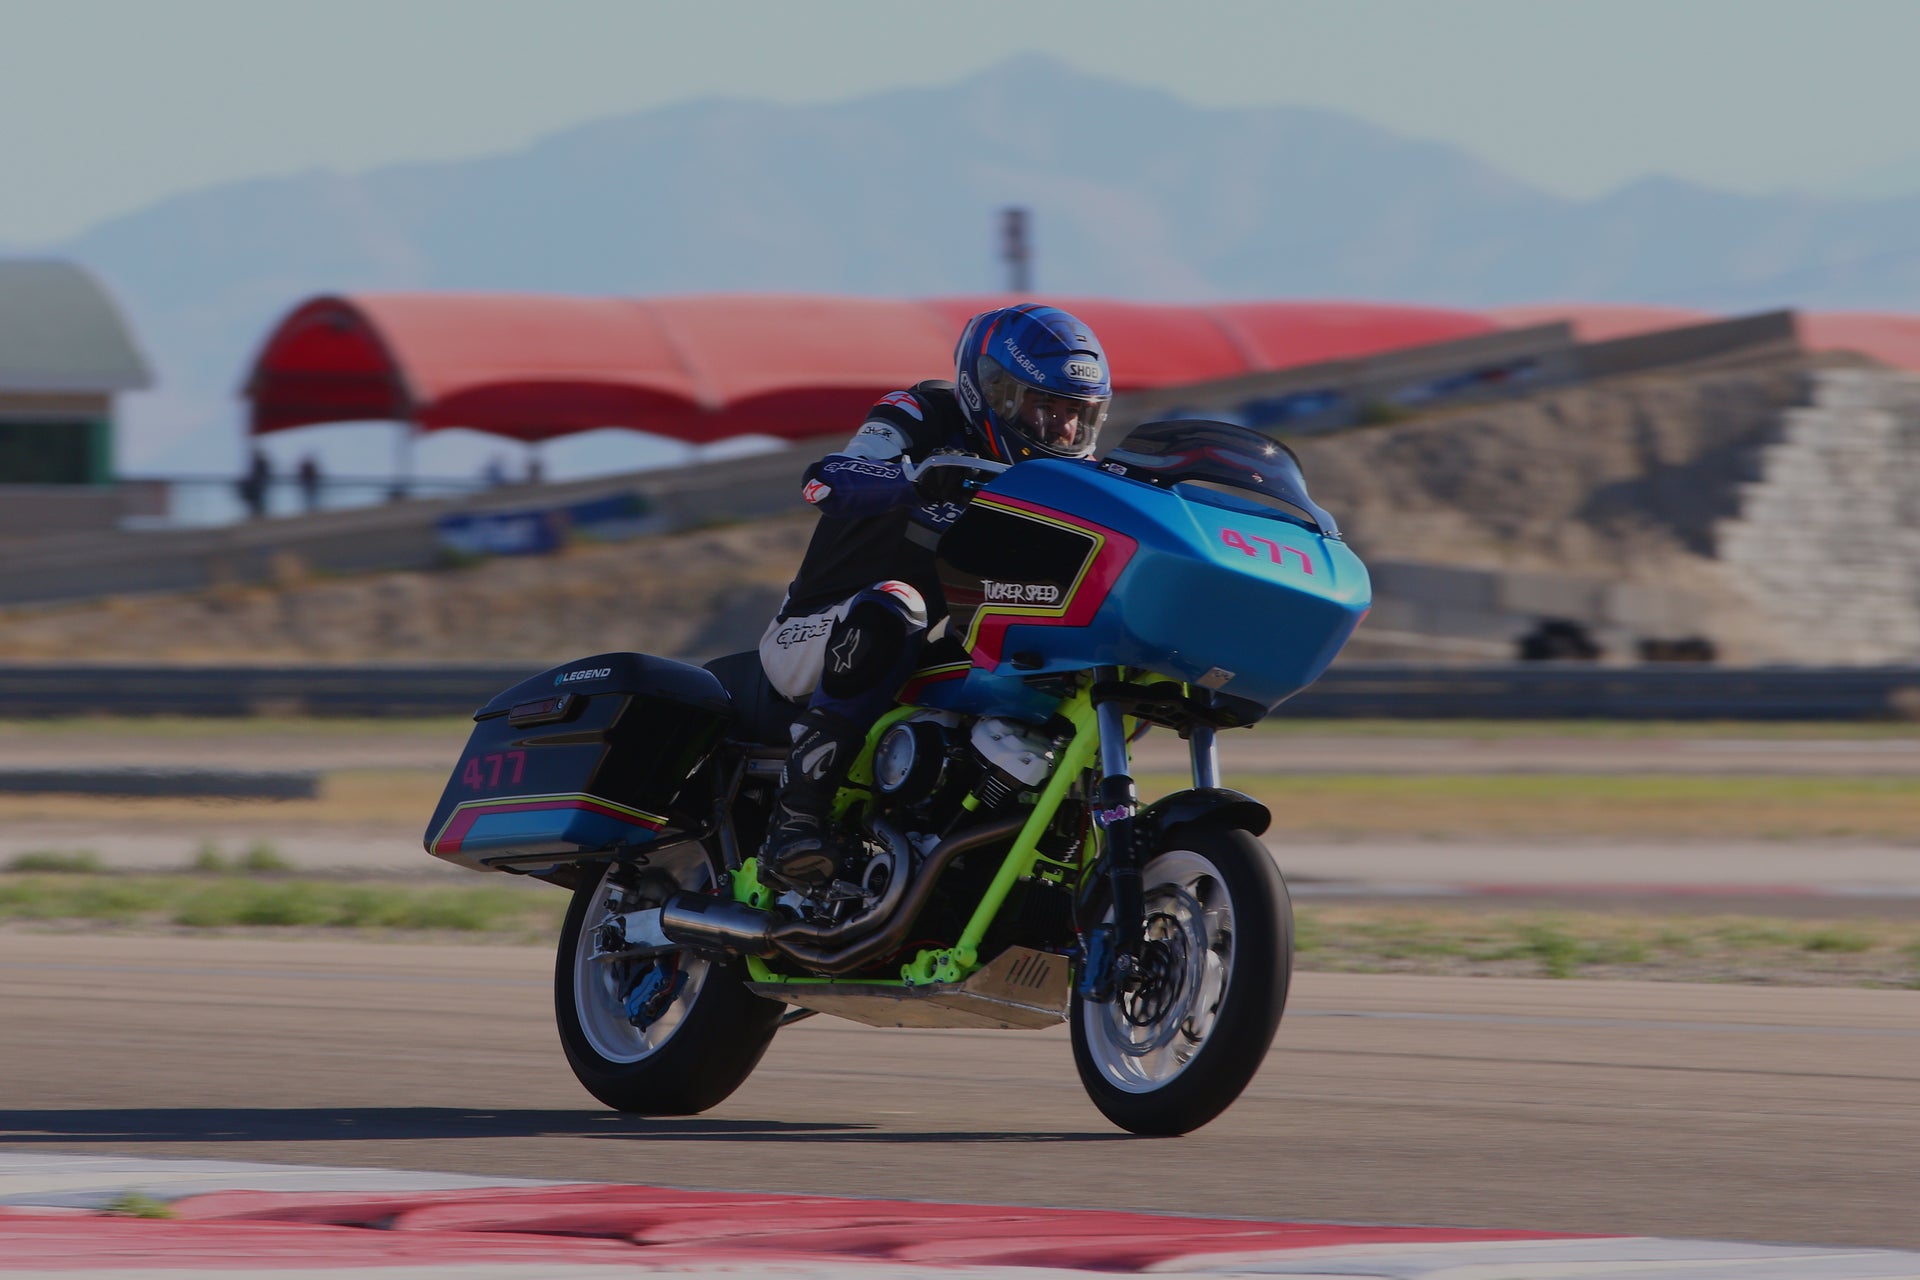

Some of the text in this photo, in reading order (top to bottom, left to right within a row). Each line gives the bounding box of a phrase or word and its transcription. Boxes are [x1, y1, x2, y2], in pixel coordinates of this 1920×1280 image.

[1003, 337, 1046, 383] PULL&BEAR
[1220, 527, 1313, 575] 477
[980, 579, 1059, 603] TUCKER SPEED
[562, 667, 612, 682] LEGEND
[461, 751, 527, 790] 477
